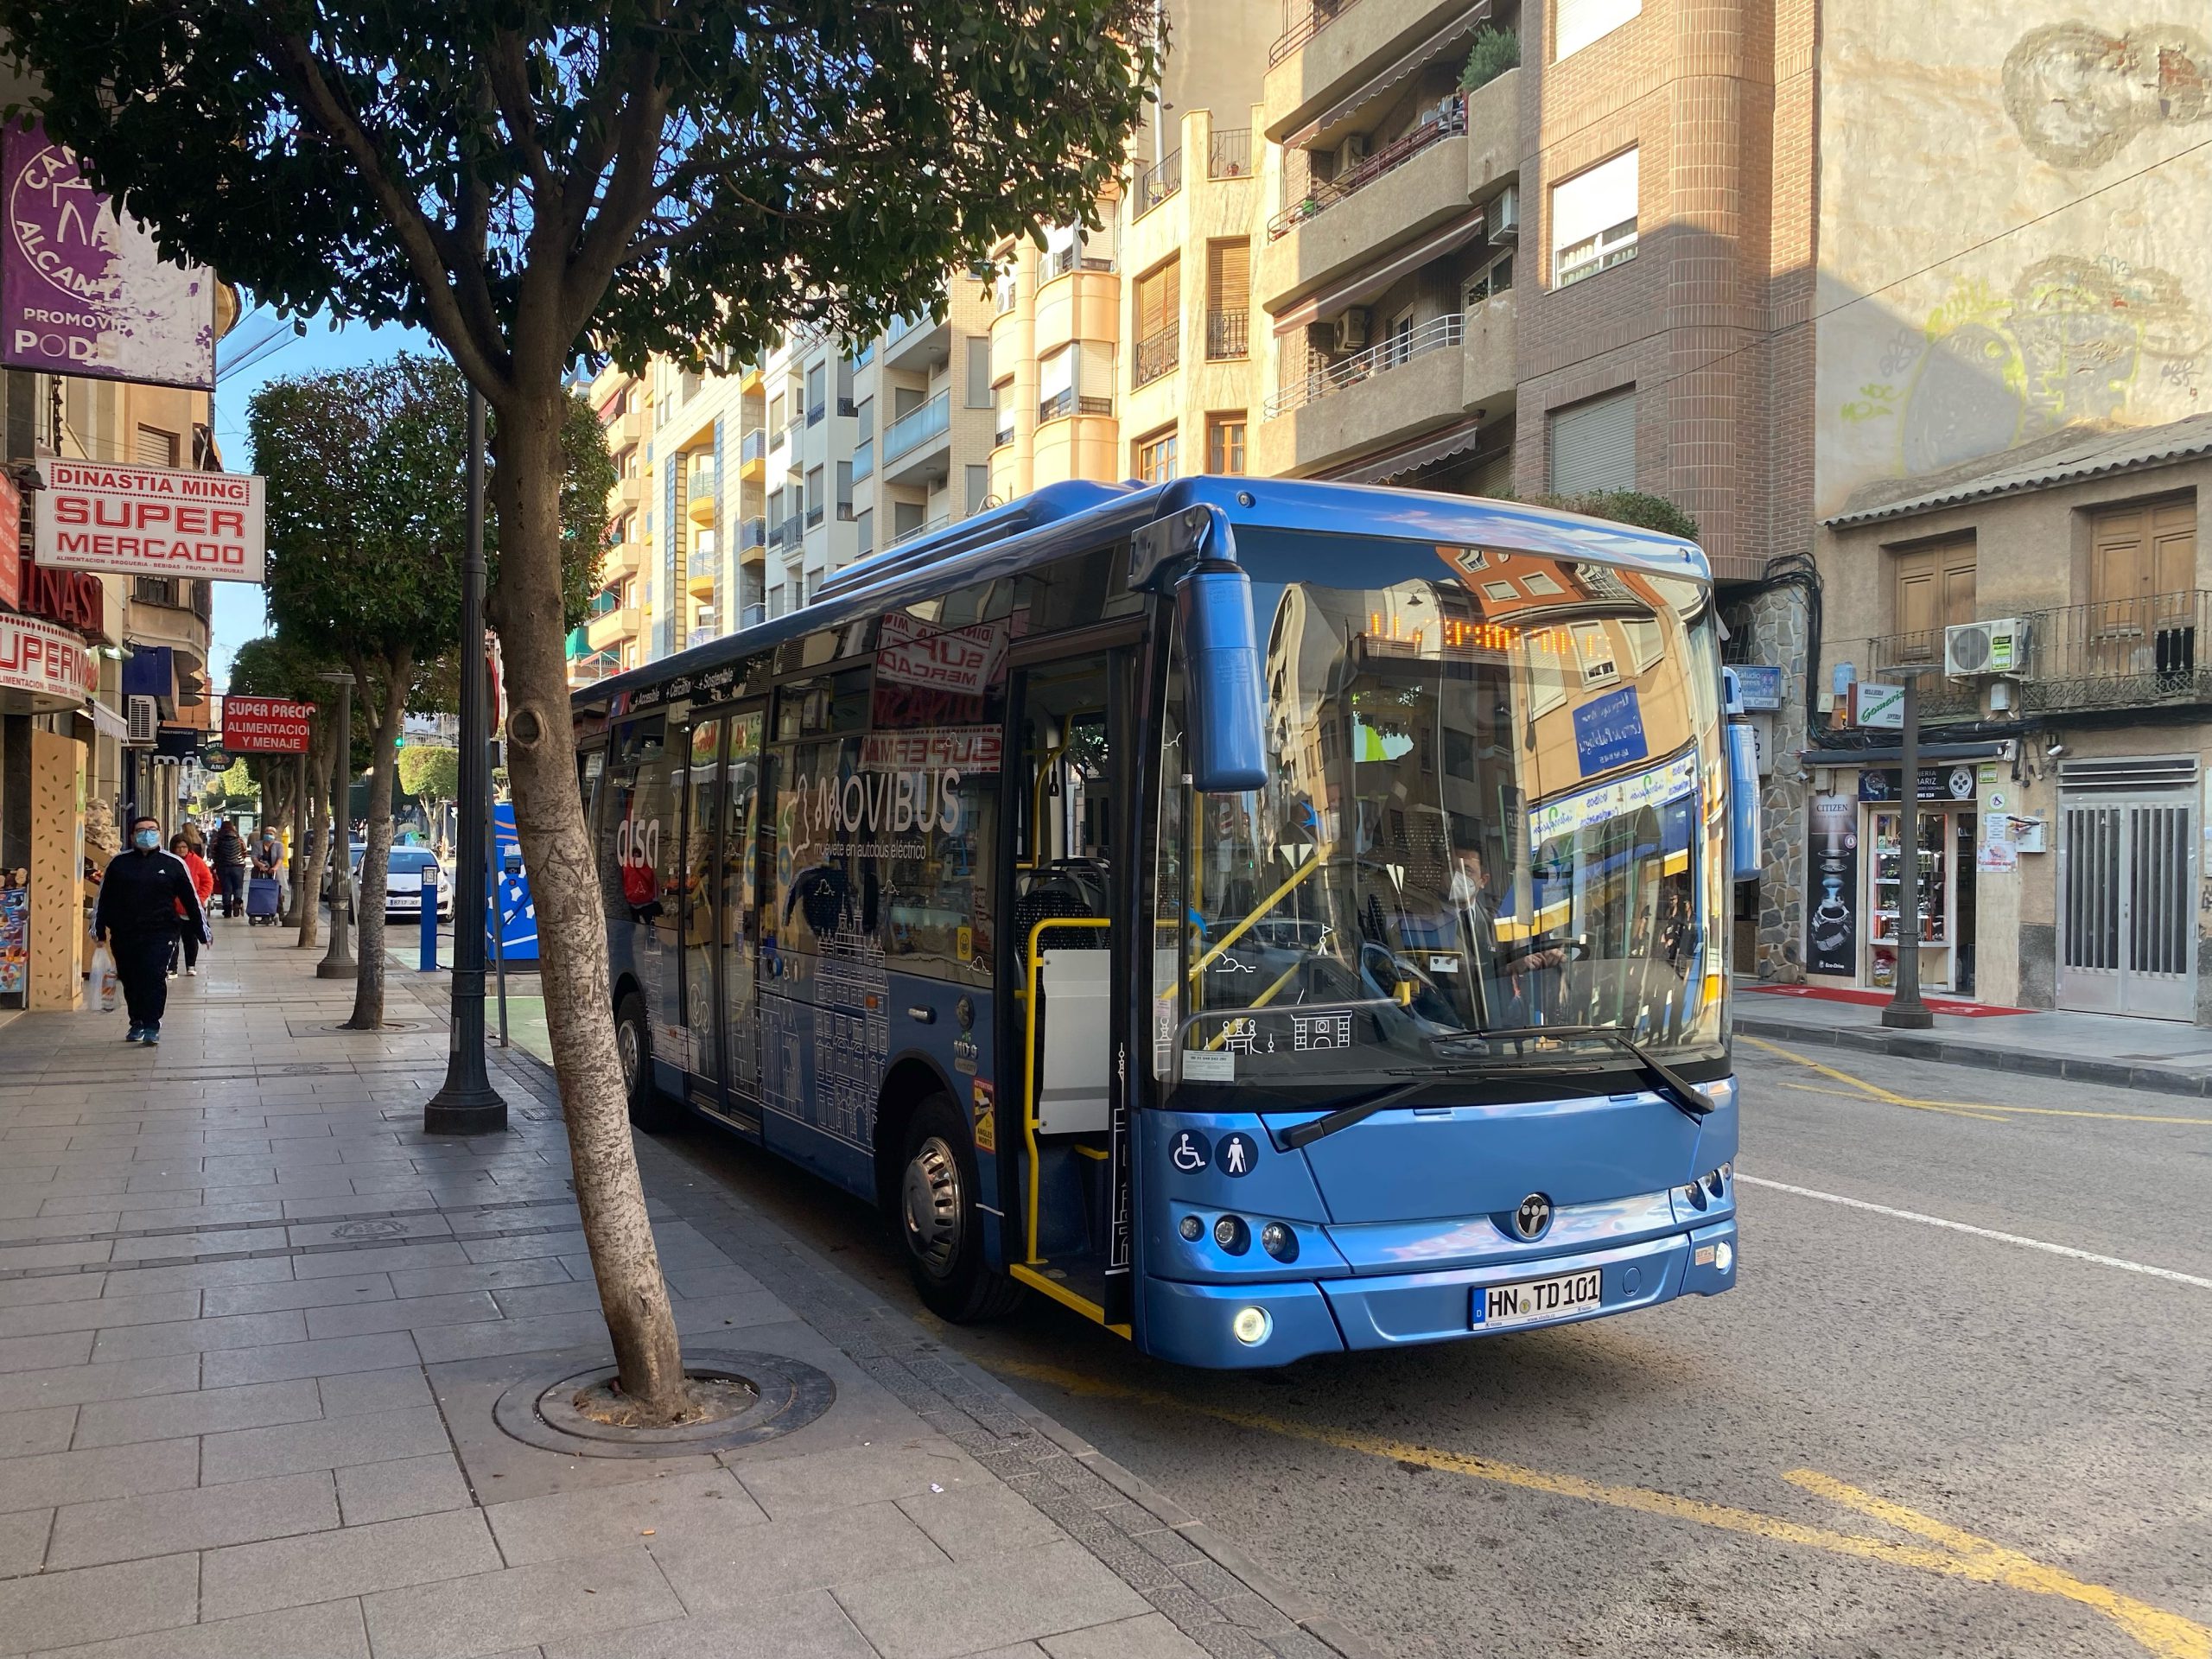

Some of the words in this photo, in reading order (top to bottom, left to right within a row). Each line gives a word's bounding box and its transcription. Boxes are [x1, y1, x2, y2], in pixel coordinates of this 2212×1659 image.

[57, 468, 173, 493] DINASTIA
[181, 480, 245, 499] MING
[54, 496, 245, 538] SUPER
[56, 531, 245, 565] MERCADO
[56, 555, 105, 564] ALIMENTACION
[0, 675, 44, 690] LIMENTACION
[228, 702, 268, 717] SUPER
[242, 736, 251, 747] Y
[253, 736, 301, 749] MENAJE
[815, 767, 961, 833] MOVIBUS
[1816, 804, 1848, 812] CITIZEN
[616, 808, 660, 869] alsa
[845, 843, 856, 858] en
[857, 838, 890, 858] autobús
[890, 838, 926, 860] eléctrico
[1476, 1309, 1482, 1318] D
[1488, 1288, 1518, 1319] HN
